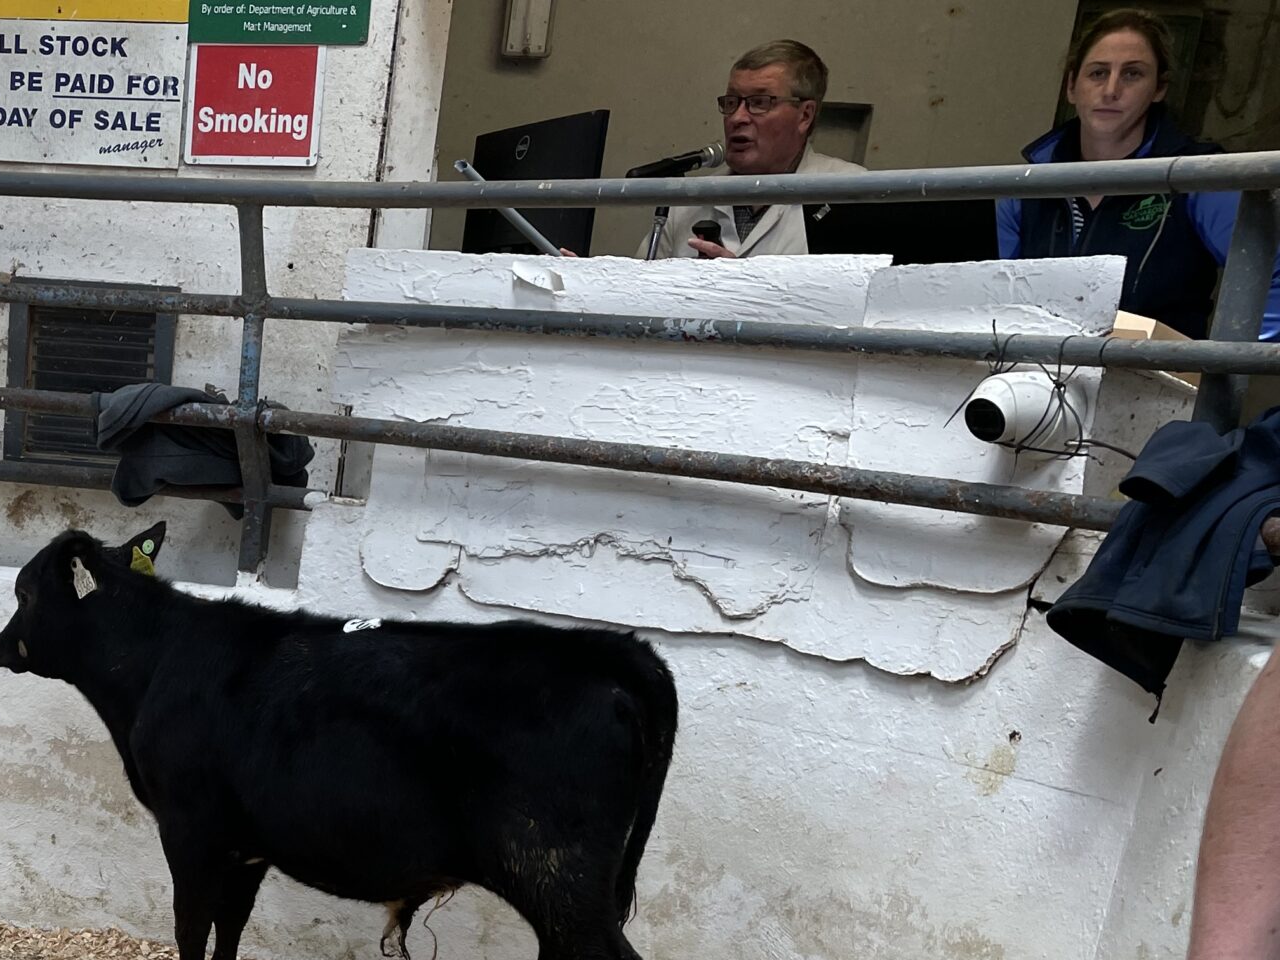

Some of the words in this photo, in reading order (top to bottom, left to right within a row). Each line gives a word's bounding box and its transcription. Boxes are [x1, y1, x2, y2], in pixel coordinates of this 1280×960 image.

[201, 3, 212, 15] By
[213, 4, 234, 14] order
[236, 4, 246, 14] of:
[249, 4, 295, 15] Department
[296, 4, 305, 14] of
[306, 5, 348, 16] Agriculture
[350, 6, 357, 15] &
[243, 21, 261, 31] Mart
[263, 21, 312, 34] Management
[39, 35, 129, 57] STOCK
[10, 71, 43, 91] BE
[54, 73, 115, 94] PAID
[126, 75, 180, 96] FOR
[237, 63, 273, 89] No
[49, 108, 84, 129] OF
[94, 110, 162, 132] SALE
[197, 106, 309, 140] Smoking
[99, 137, 164, 154] manager
